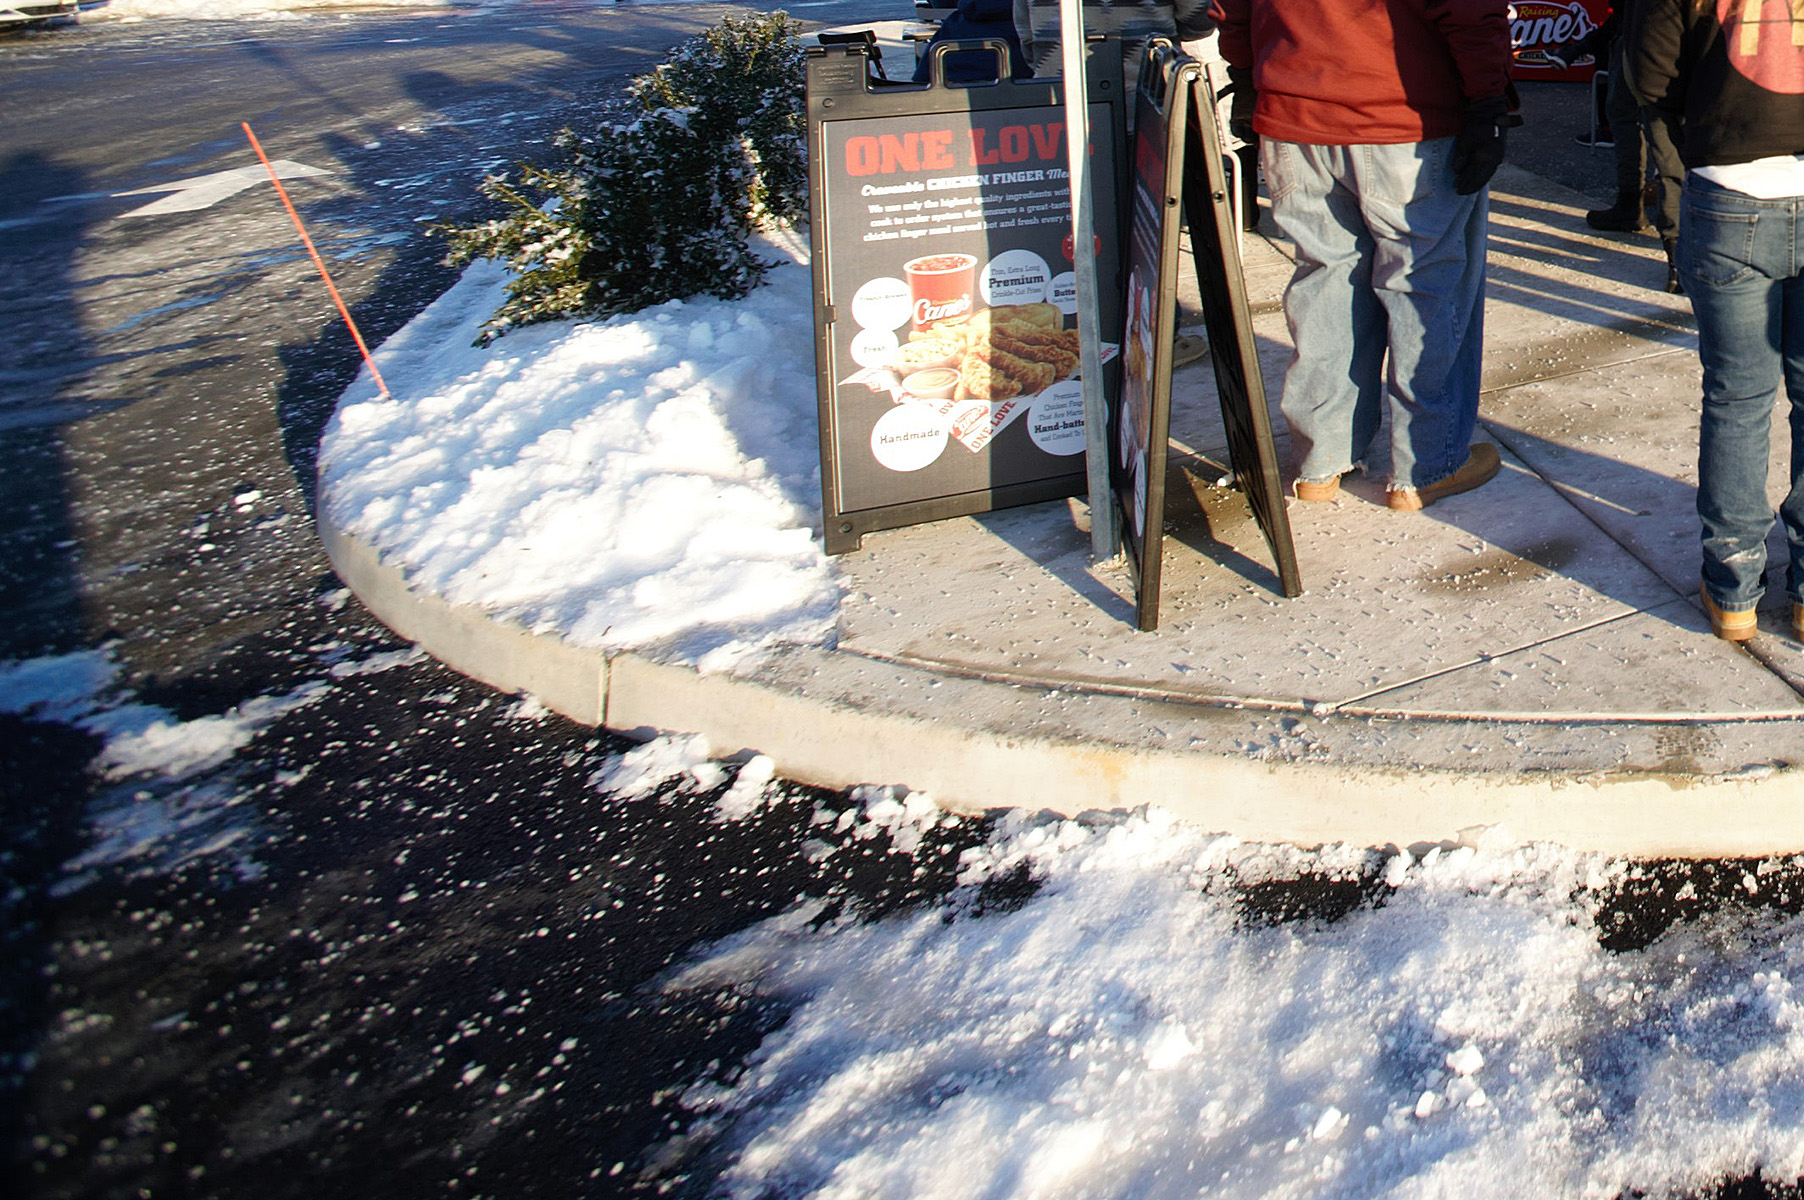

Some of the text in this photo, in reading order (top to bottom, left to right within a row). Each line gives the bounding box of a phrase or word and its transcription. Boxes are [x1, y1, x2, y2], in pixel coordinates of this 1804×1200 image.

[1519, 5, 1560, 18] Raising
[1507, 4, 1594, 49] ane's
[845, 130, 955, 177] ONE
[926, 174, 990, 191] CHICKEN
[992, 169, 1045, 185] FINGER
[1046, 168, 1070, 180] Me
[973, 194, 1004, 205] quality
[1005, 189, 1053, 201] ingredients
[1026, 201, 1071, 213] great-tasti
[999, 218, 1016, 228] and
[1017, 216, 1040, 227] fresh
[1041, 214, 1065, 224] every
[1025, 264, 1041, 273] Long
[988, 275, 1045, 289] Premium
[1054, 288, 1077, 297] Butte
[1068, 400, 1083, 408] Fing
[990, 401, 1017, 427] LOVE
[1034, 419, 1085, 434] Hand-batt
[880, 429, 940, 445] Handmade
[971, 426, 994, 449] ONE
